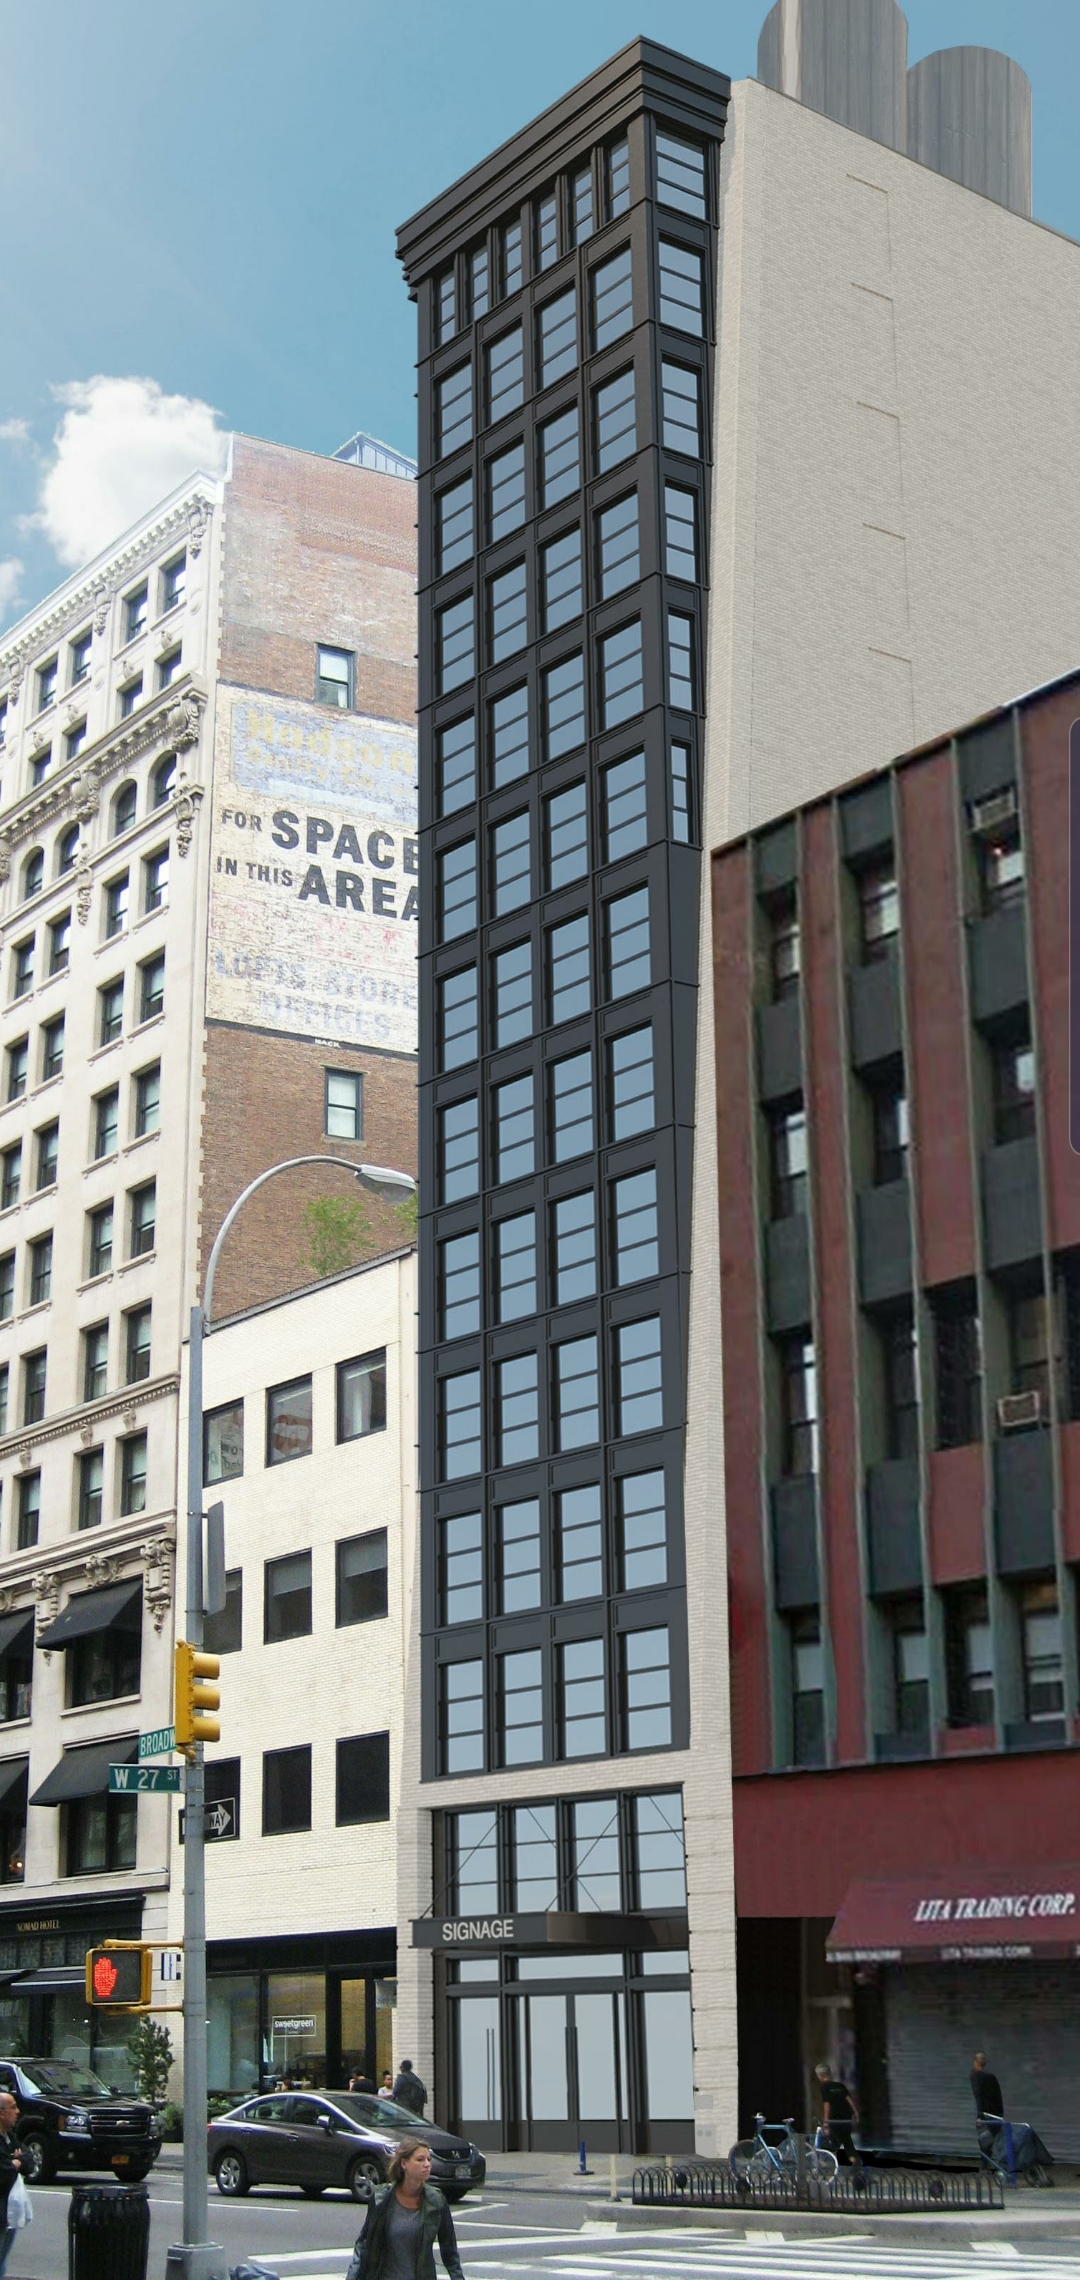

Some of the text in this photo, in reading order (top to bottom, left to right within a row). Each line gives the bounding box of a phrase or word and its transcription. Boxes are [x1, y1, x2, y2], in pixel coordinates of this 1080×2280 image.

[221, 808, 418, 876] FOR SPACE
[216, 856, 419, 922] IN THIS AREA
[140, 1728, 175, 1756] BROADW
[114, 1768, 178, 1789] W 27 ST
[914, 1893, 1075, 1922] LITA TRADING CORP.
[17, 1919, 60, 1931] NOMAD HOTEL
[442, 1919, 514, 1942] SIGNAGE
[274, 2018, 314, 2029] sweetgreen
